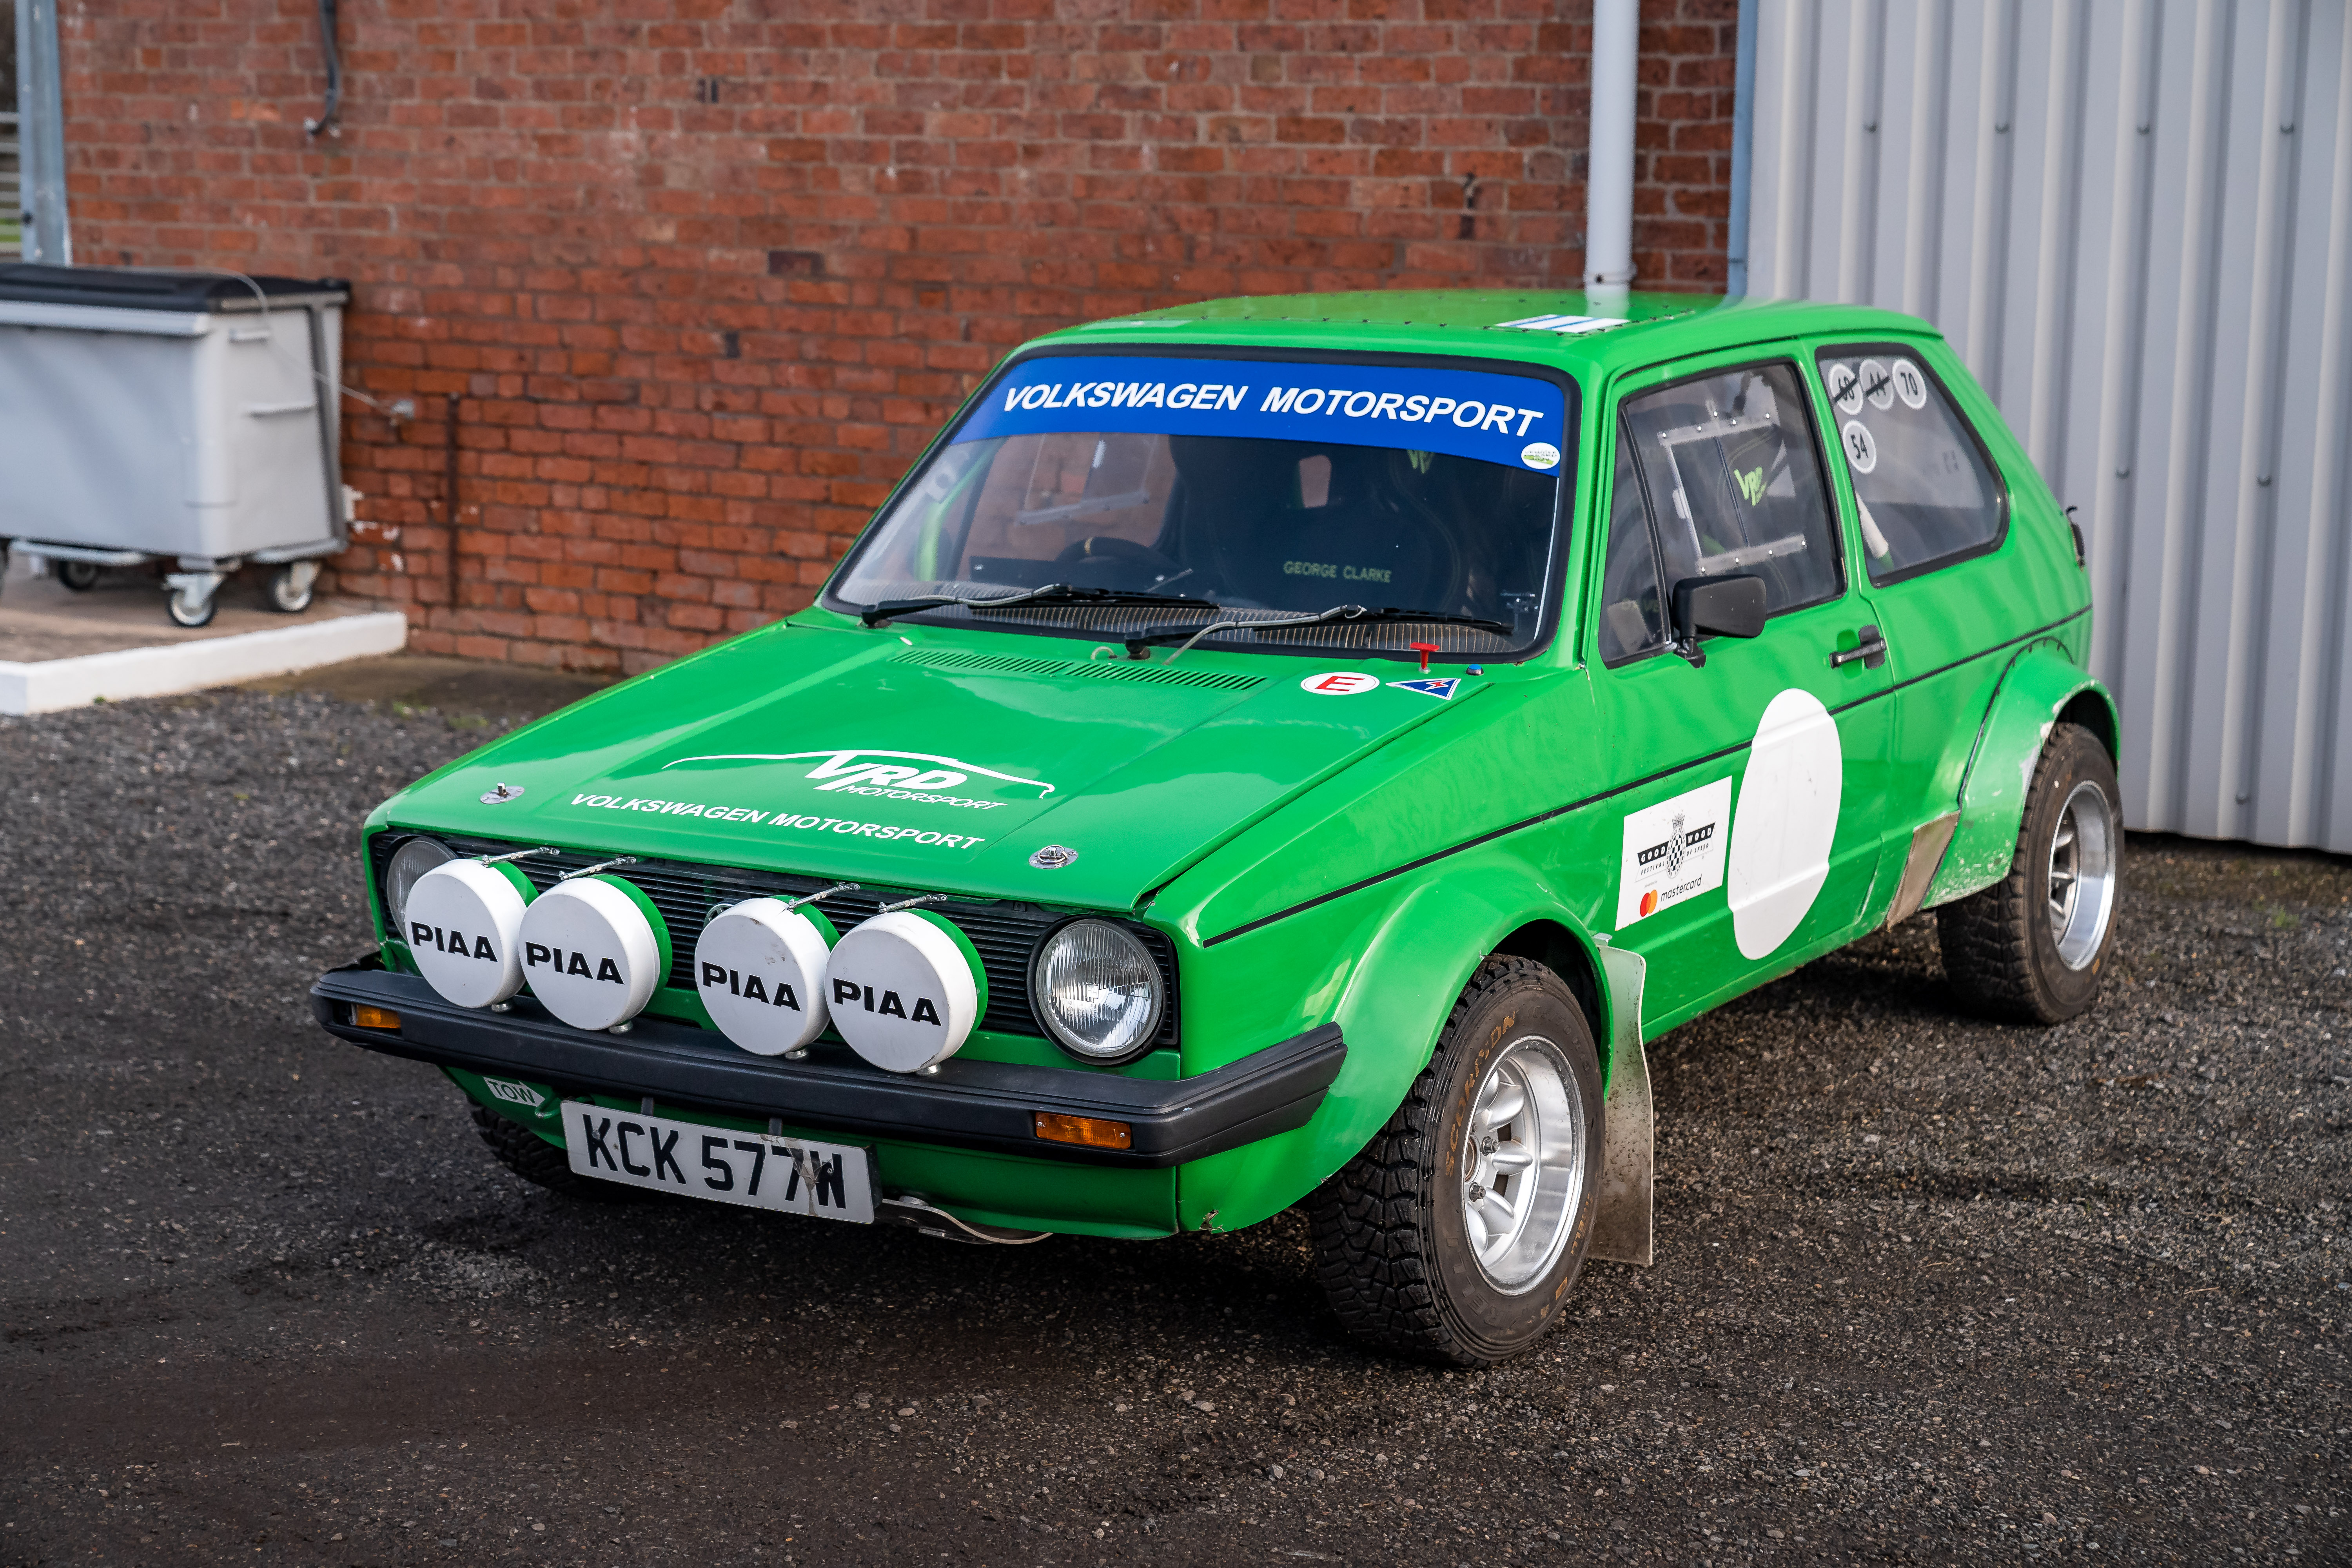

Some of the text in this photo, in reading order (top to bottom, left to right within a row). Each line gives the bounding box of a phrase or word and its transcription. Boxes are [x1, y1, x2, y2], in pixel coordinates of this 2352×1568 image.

[1900, 372, 1918, 396] 70
[1004, 381, 1544, 437] VOLKSWAGEN MOTORSPORT
[1851, 432, 1869, 459] 54
[1283, 561, 1392, 583] GEORGE CLARKE
[1315, 676, 1365, 692] E
[804, 751, 967, 791] VRD
[835, 785, 1008, 810] MOTORSPORT
[571, 793, 985, 849] VOLKSWAGEN MOTORSPORT
[1661, 874, 1702, 902] mastercard
[411, 921, 498, 962] PIAA
[525, 941, 624, 985] PIAA
[702, 961, 801, 1012] PIAA
[833, 977, 942, 1027] PIAA
[487, 1080, 536, 1104] TOW
[582, 1113, 847, 1209] KCK 577W
